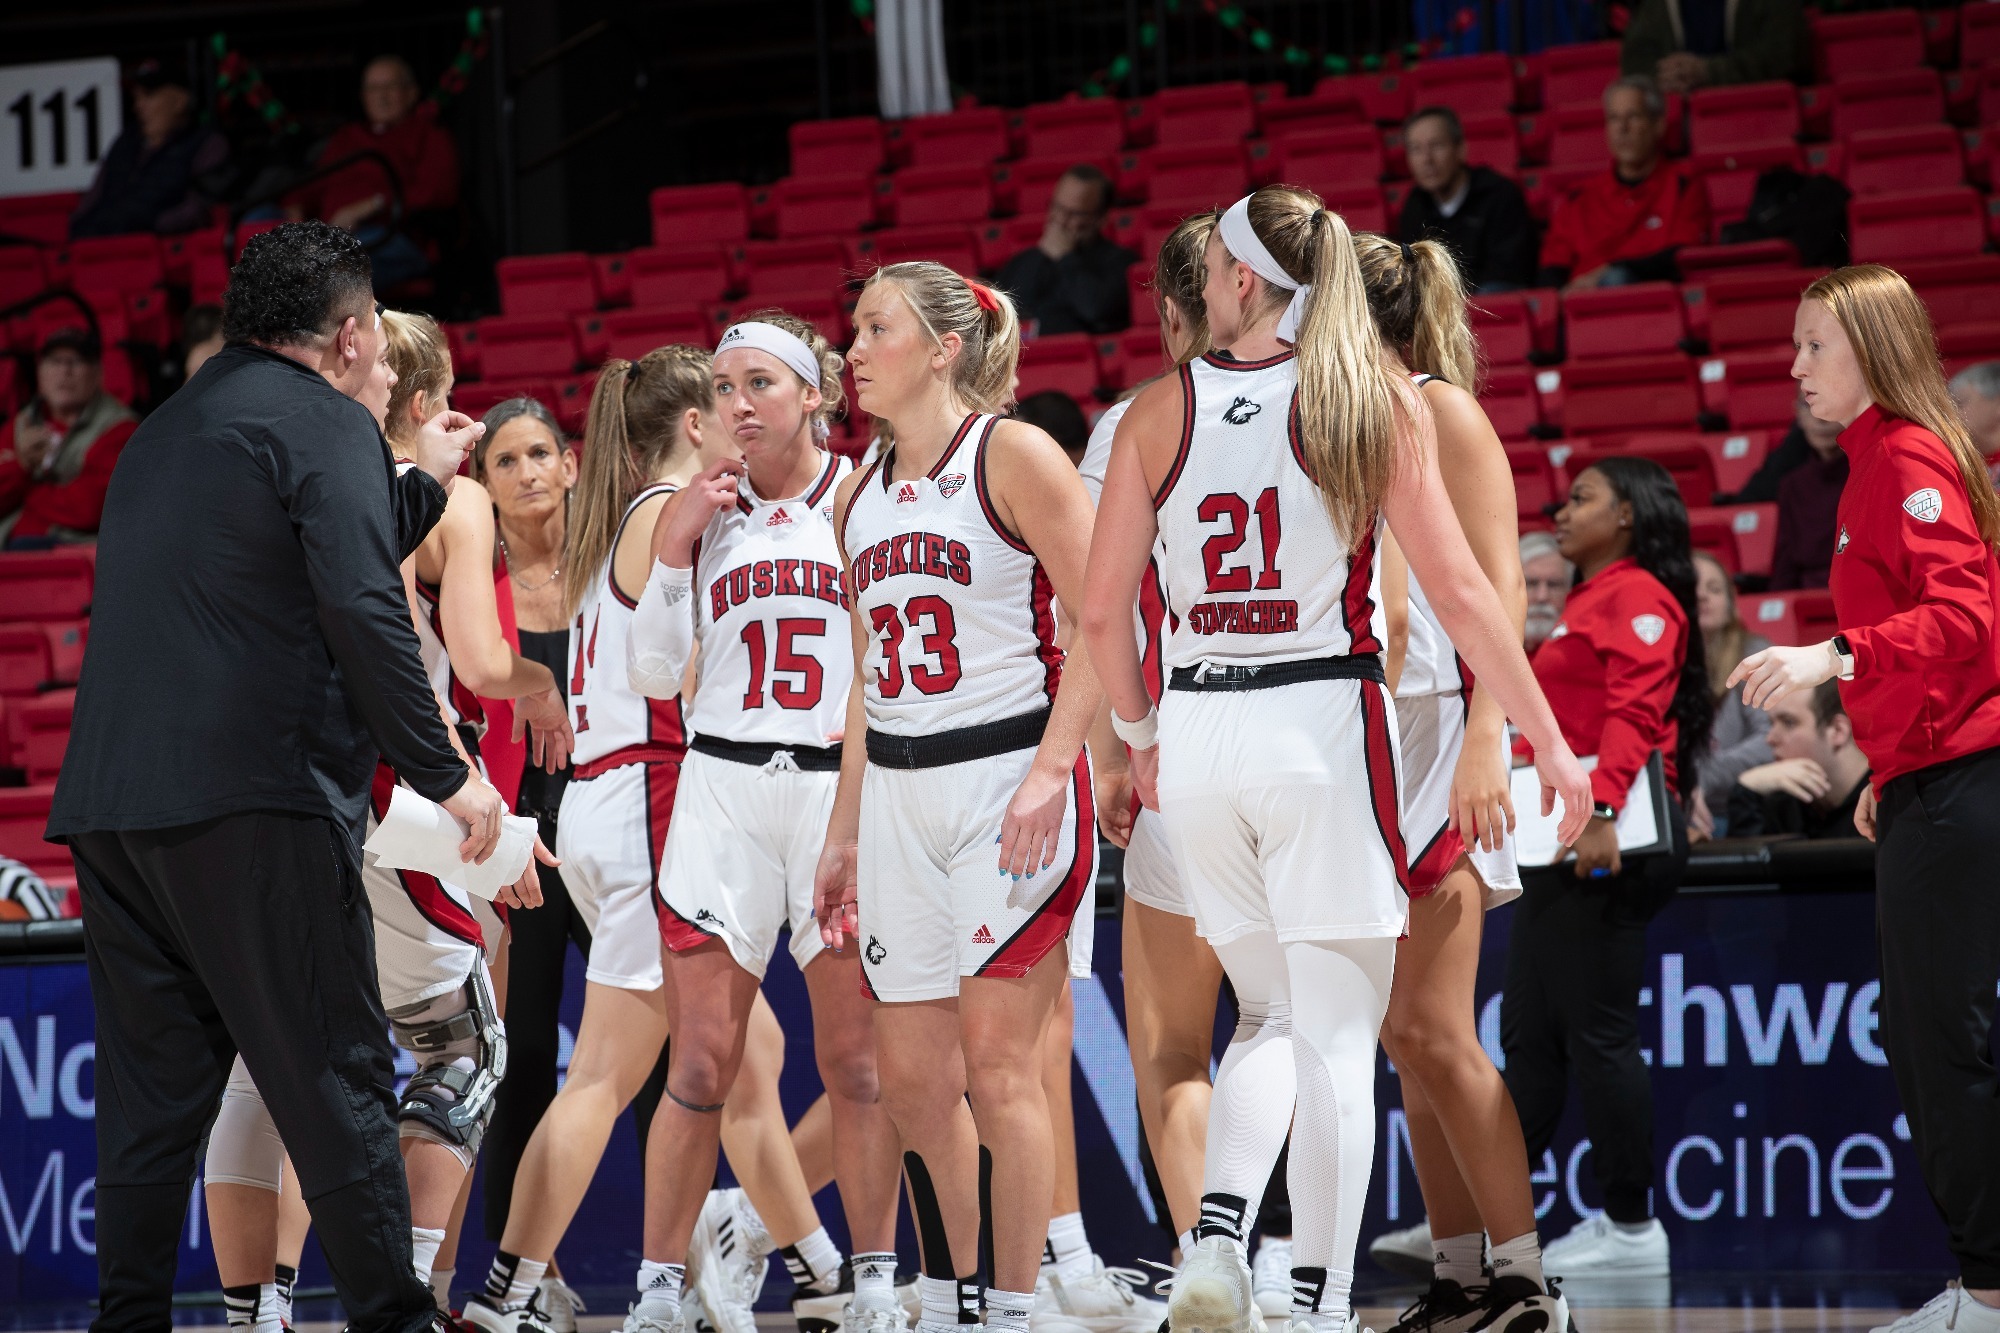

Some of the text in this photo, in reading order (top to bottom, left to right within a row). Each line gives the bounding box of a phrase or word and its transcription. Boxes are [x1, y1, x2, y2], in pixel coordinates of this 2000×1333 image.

[8, 86, 98, 169] 111
[766, 517, 793, 527] adidas
[1197, 487, 1282, 594] 21
[740, 617, 827, 711] 15
[869, 595, 963, 699] 33
